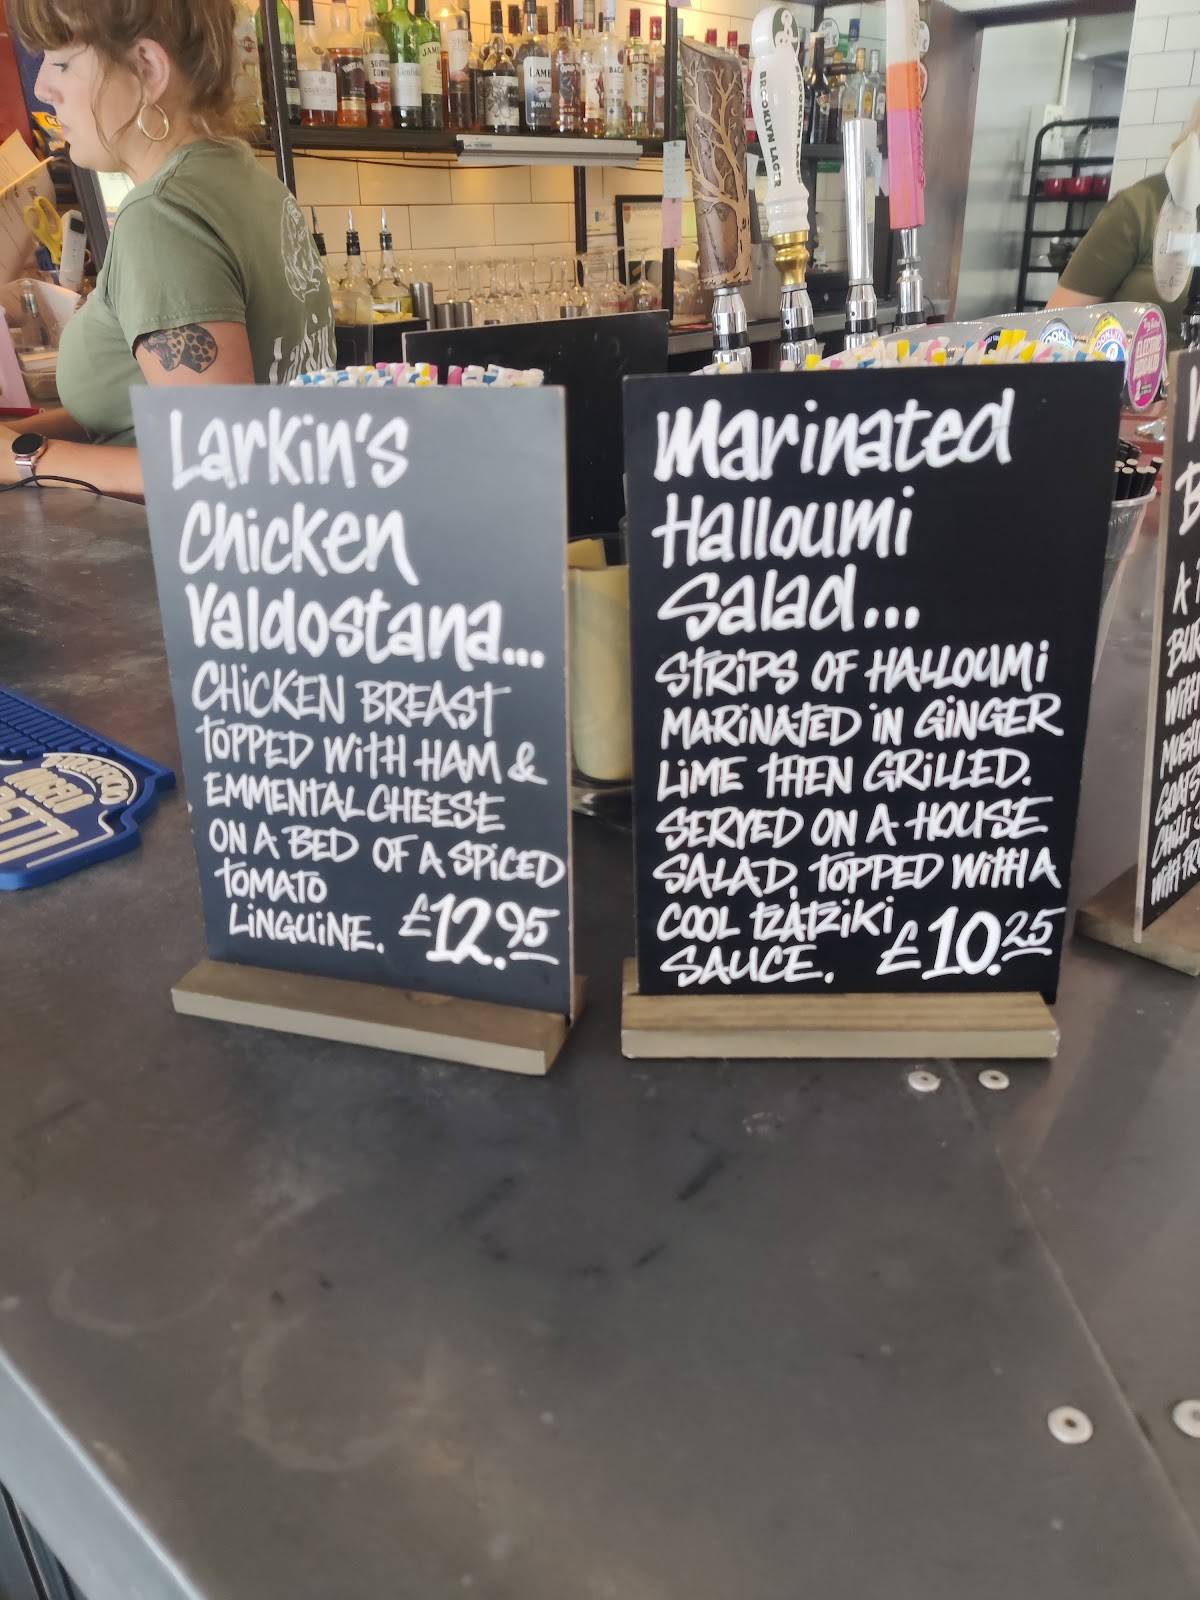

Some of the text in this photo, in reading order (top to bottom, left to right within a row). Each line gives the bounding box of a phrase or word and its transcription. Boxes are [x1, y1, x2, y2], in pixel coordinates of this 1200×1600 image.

[760, 71, 782, 188] BROOKLYN LAGER
[170, 407, 409, 490] Larkin's
[653, 387, 1015, 483] Marinated
[179, 499, 420, 587] Chicken
[651, 485, 915, 569] Halloumi
[657, 563, 921, 641] Salad...
[811, 648, 860, 693] OF
[355, 680, 512, 737] BREAST
[413, 738, 502, 785] HAM
[507, 741, 549, 786] &
[367, 783, 506, 835] CHEESE
[655, 797, 1054, 851] SERVED ON A HOUSE
[208, 818, 248, 855] ON
[252, 821, 280, 860] A
[281, 825, 360, 863] BED
[371, 834, 419, 873] OF
[418, 841, 446, 879] A
[1028, 846, 1062, 889] A
[656, 902, 741, 943] COOL
[660, 944, 835, 988] SAUCE.
